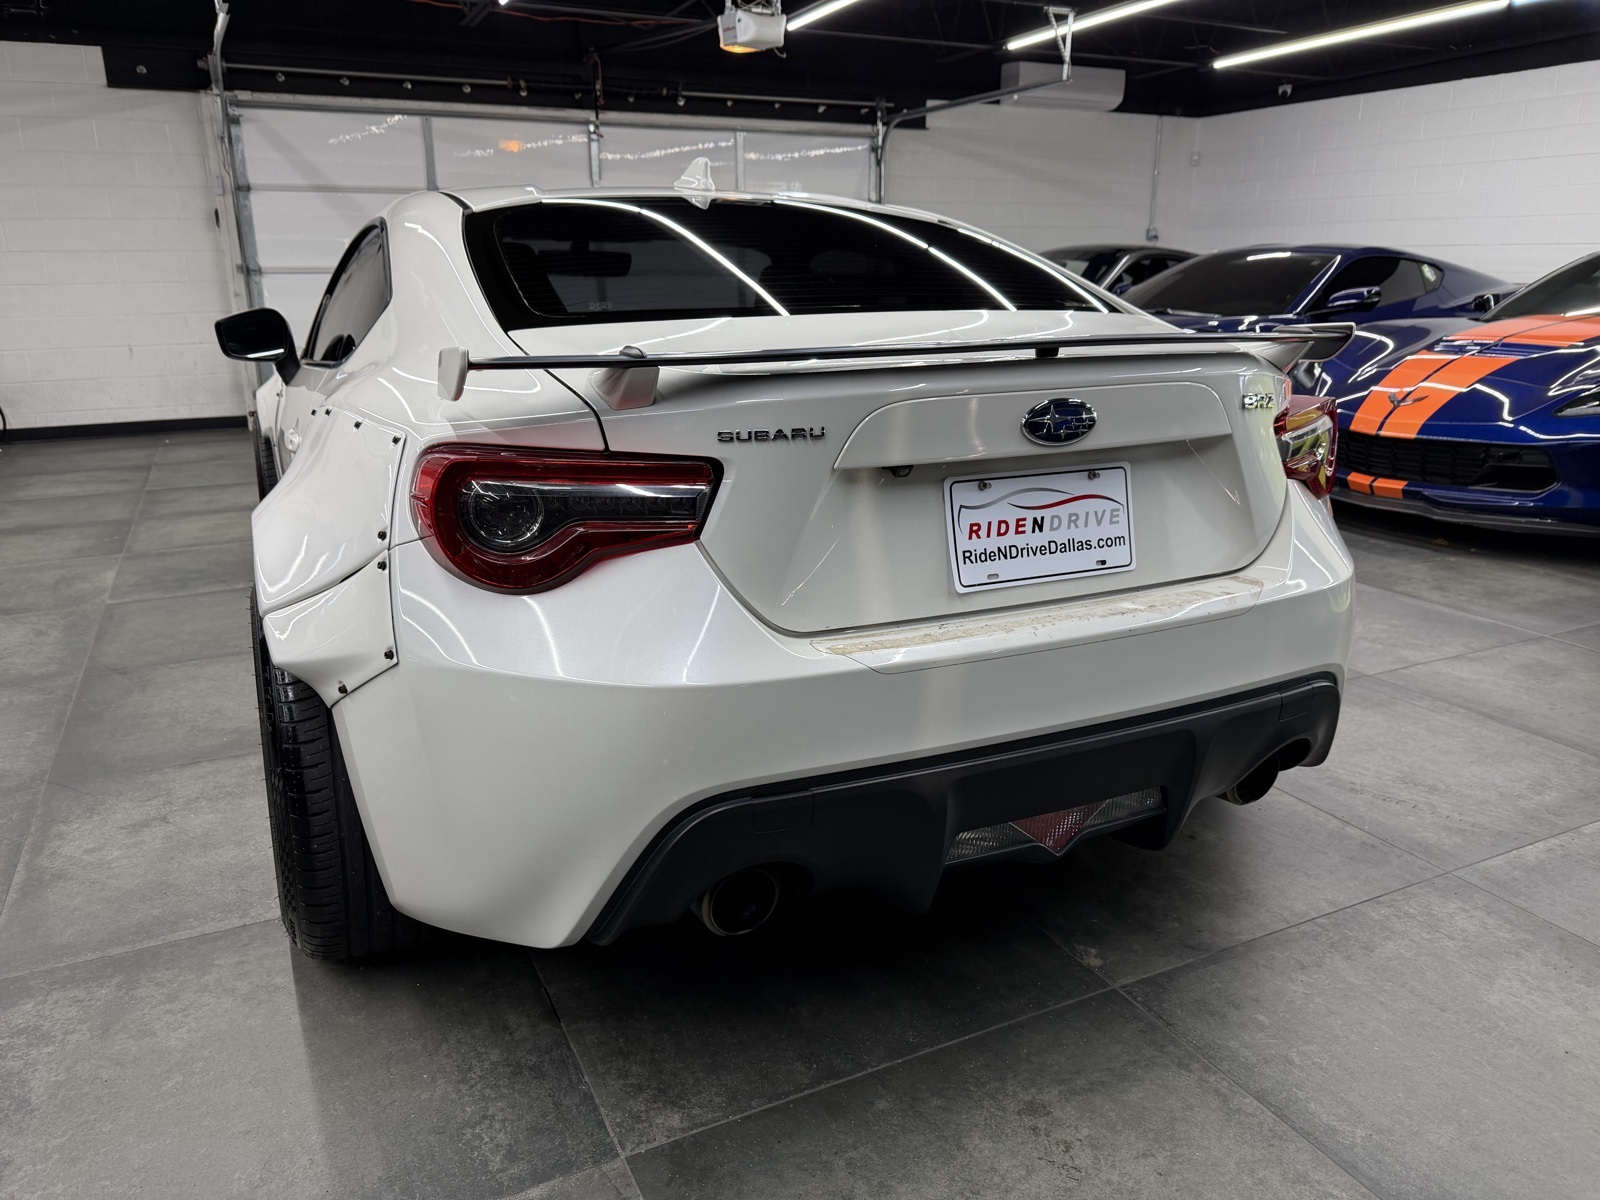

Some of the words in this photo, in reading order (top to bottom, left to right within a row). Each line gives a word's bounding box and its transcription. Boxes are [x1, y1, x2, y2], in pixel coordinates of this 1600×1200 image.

[717, 427, 825, 442] SUBARU
[968, 508, 1121, 540] RIDENDRIVE
[962, 535, 1126, 565] RideNDriveDallas.com
